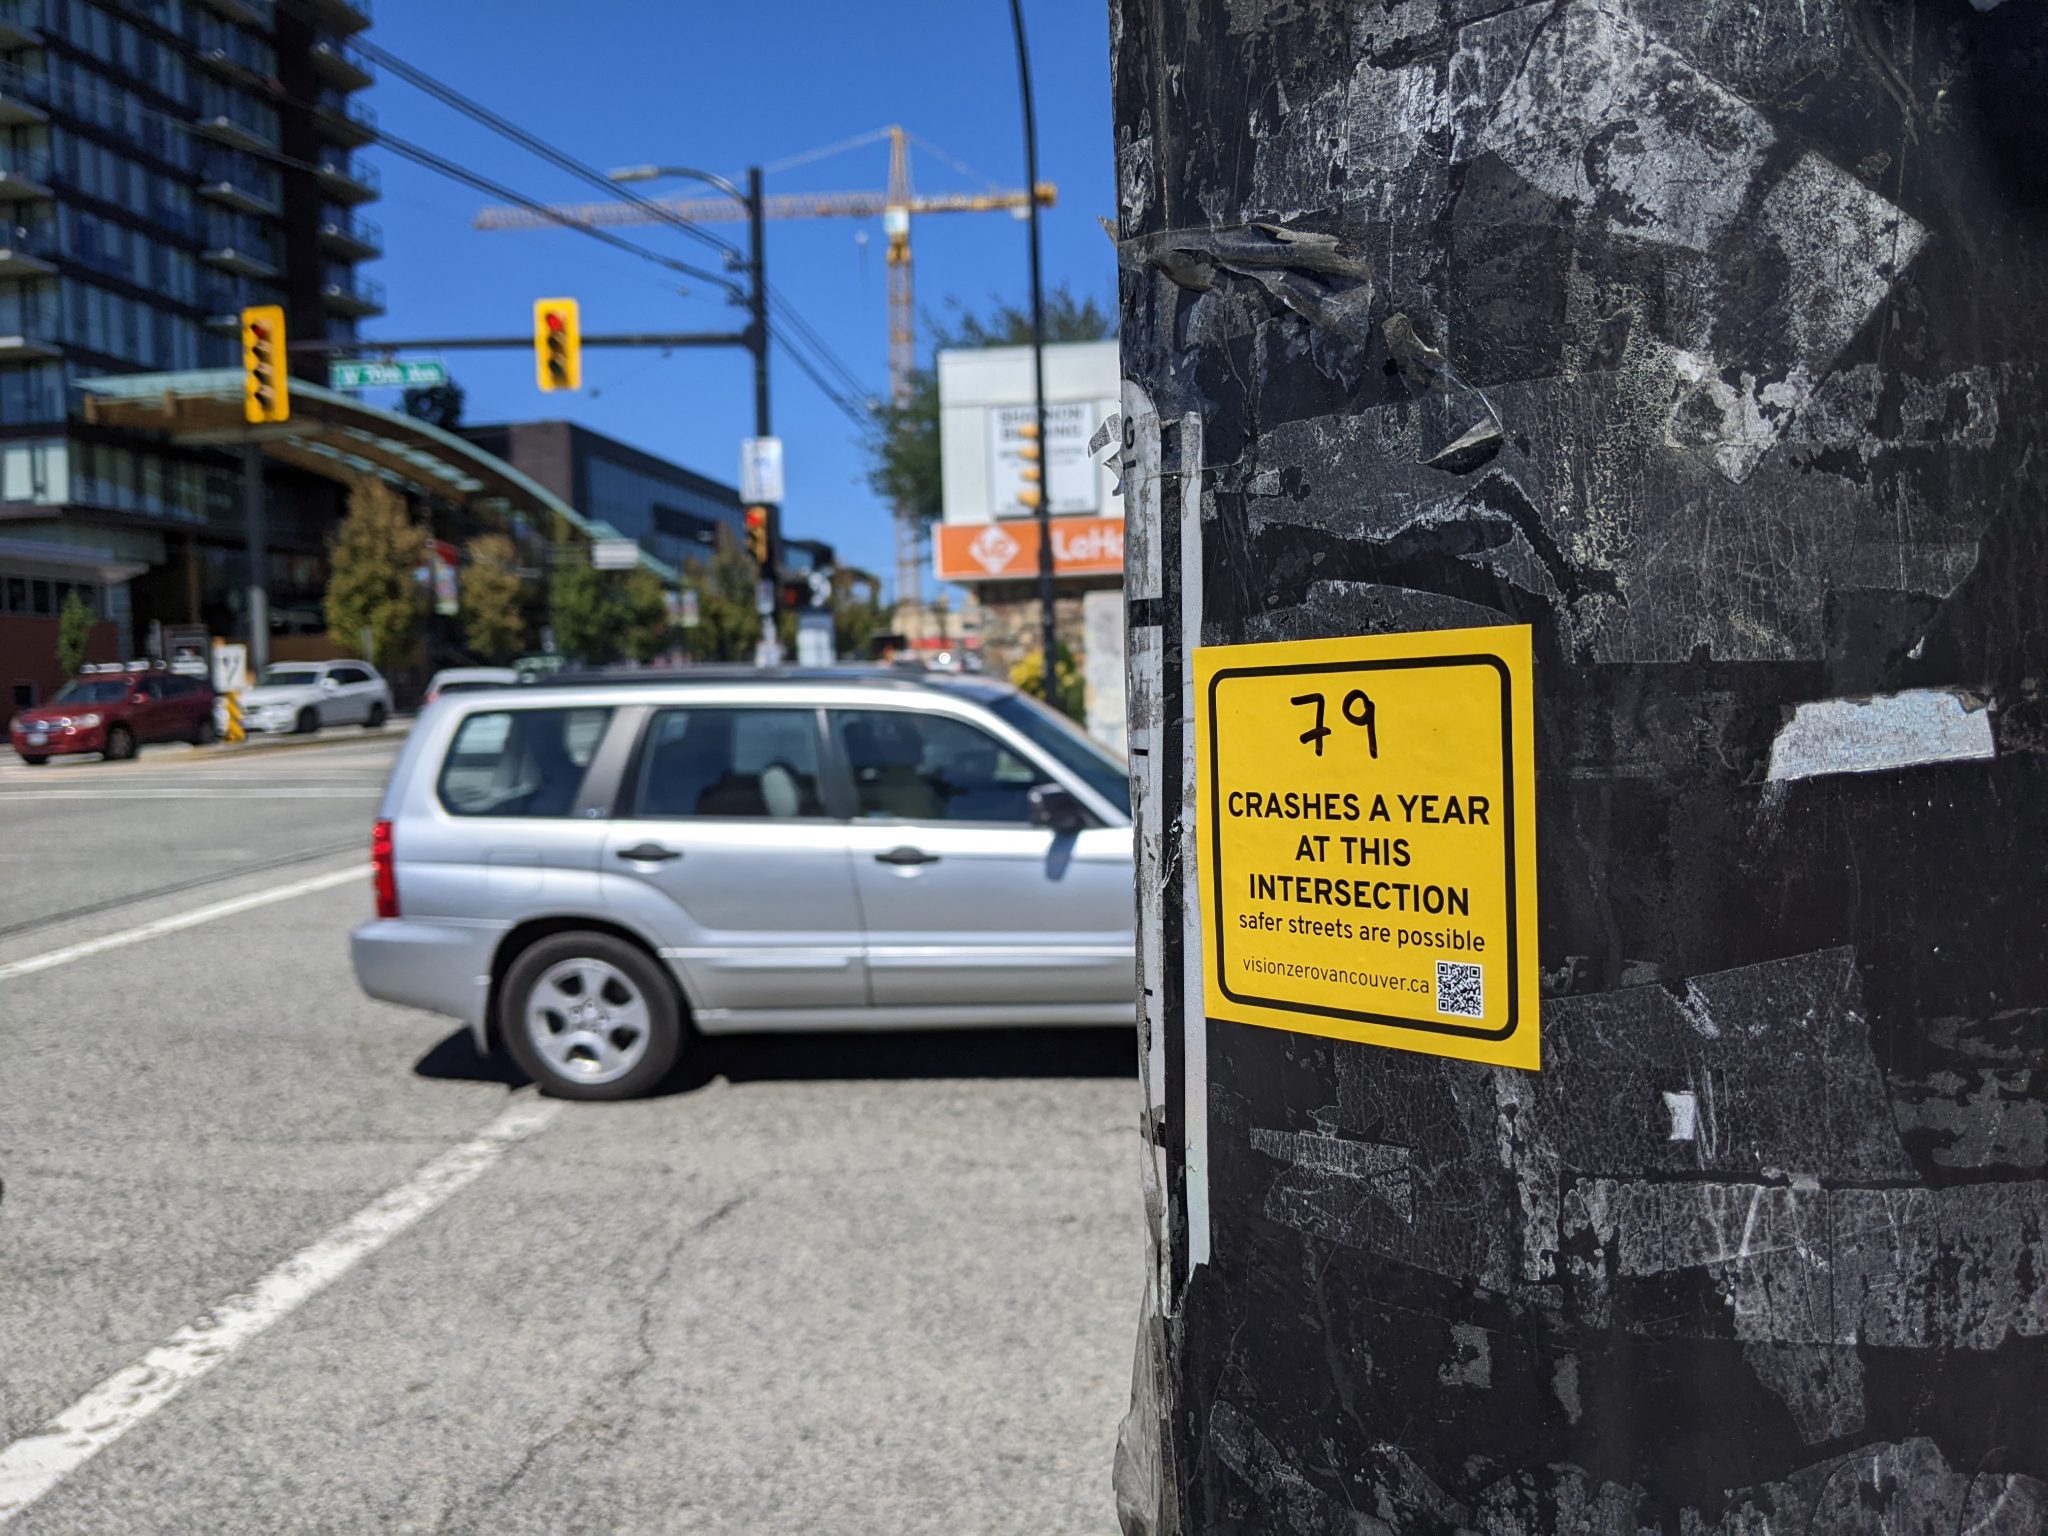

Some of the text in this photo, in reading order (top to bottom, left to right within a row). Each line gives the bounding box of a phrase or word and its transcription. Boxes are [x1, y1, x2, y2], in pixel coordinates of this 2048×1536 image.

[1291, 690, 1378, 760] 79
[1228, 791, 1490, 825] CRASHES A YEAR
[1295, 834, 1411, 867] AT THIS
[1249, 873, 1469, 917] INTERSECTION
[1239, 912, 1486, 952] safer streets are possible
[1243, 957, 1430, 994] visionzerovancouver.ca
